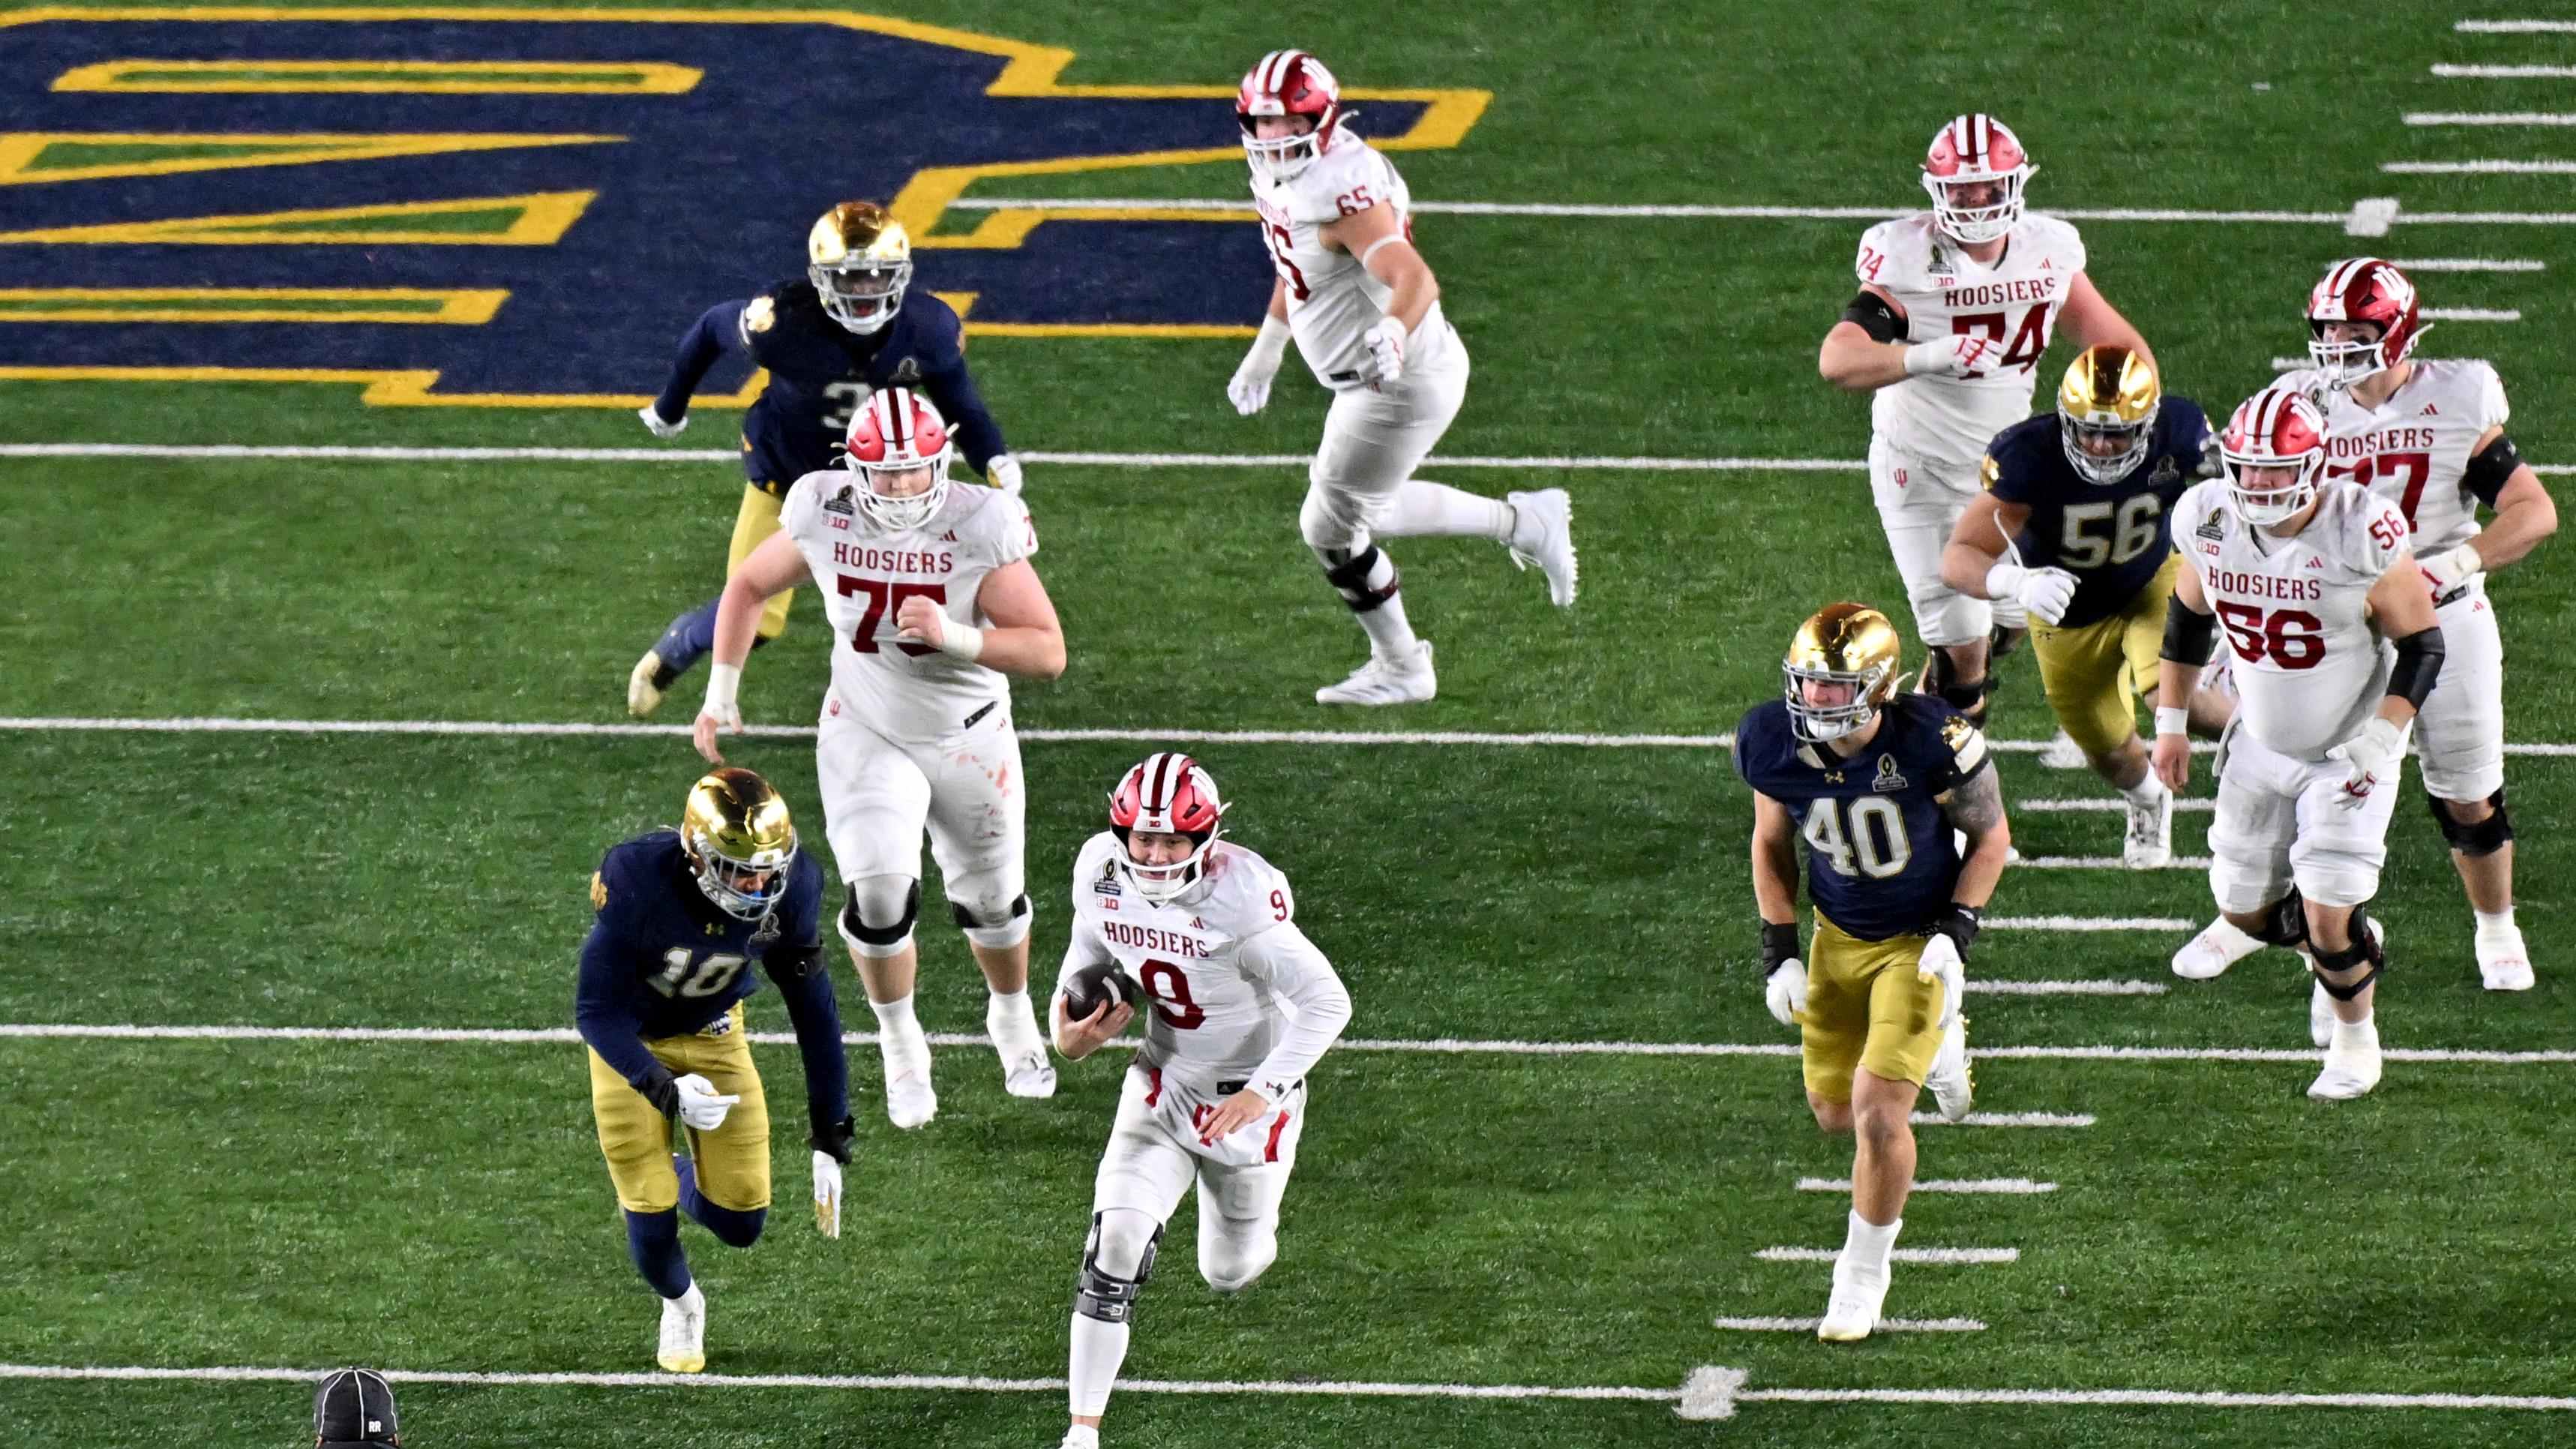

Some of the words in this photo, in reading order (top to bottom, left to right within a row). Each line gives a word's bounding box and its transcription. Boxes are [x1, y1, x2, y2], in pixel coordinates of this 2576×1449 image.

[1336, 184, 1375, 217] 65
[1261, 216, 1311, 301] 5
[1857, 245, 1885, 280] 74
[1945, 276, 2056, 308] HOOSIERS
[1952, 301, 2052, 380] 74
[2058, 492, 2161, 569] 56
[2368, 509, 2404, 550] 56
[833, 541, 953, 573] HOOSIERS
[2207, 566, 2322, 600] HOOSIERS
[2215, 599, 2326, 670] 56
[1803, 795, 1913, 879] 40
[1270, 890, 1288, 922] 9
[1103, 920, 1210, 958] HOOSIERS
[646, 946, 745, 998] 10
[1139, 958, 1207, 1030] 9
